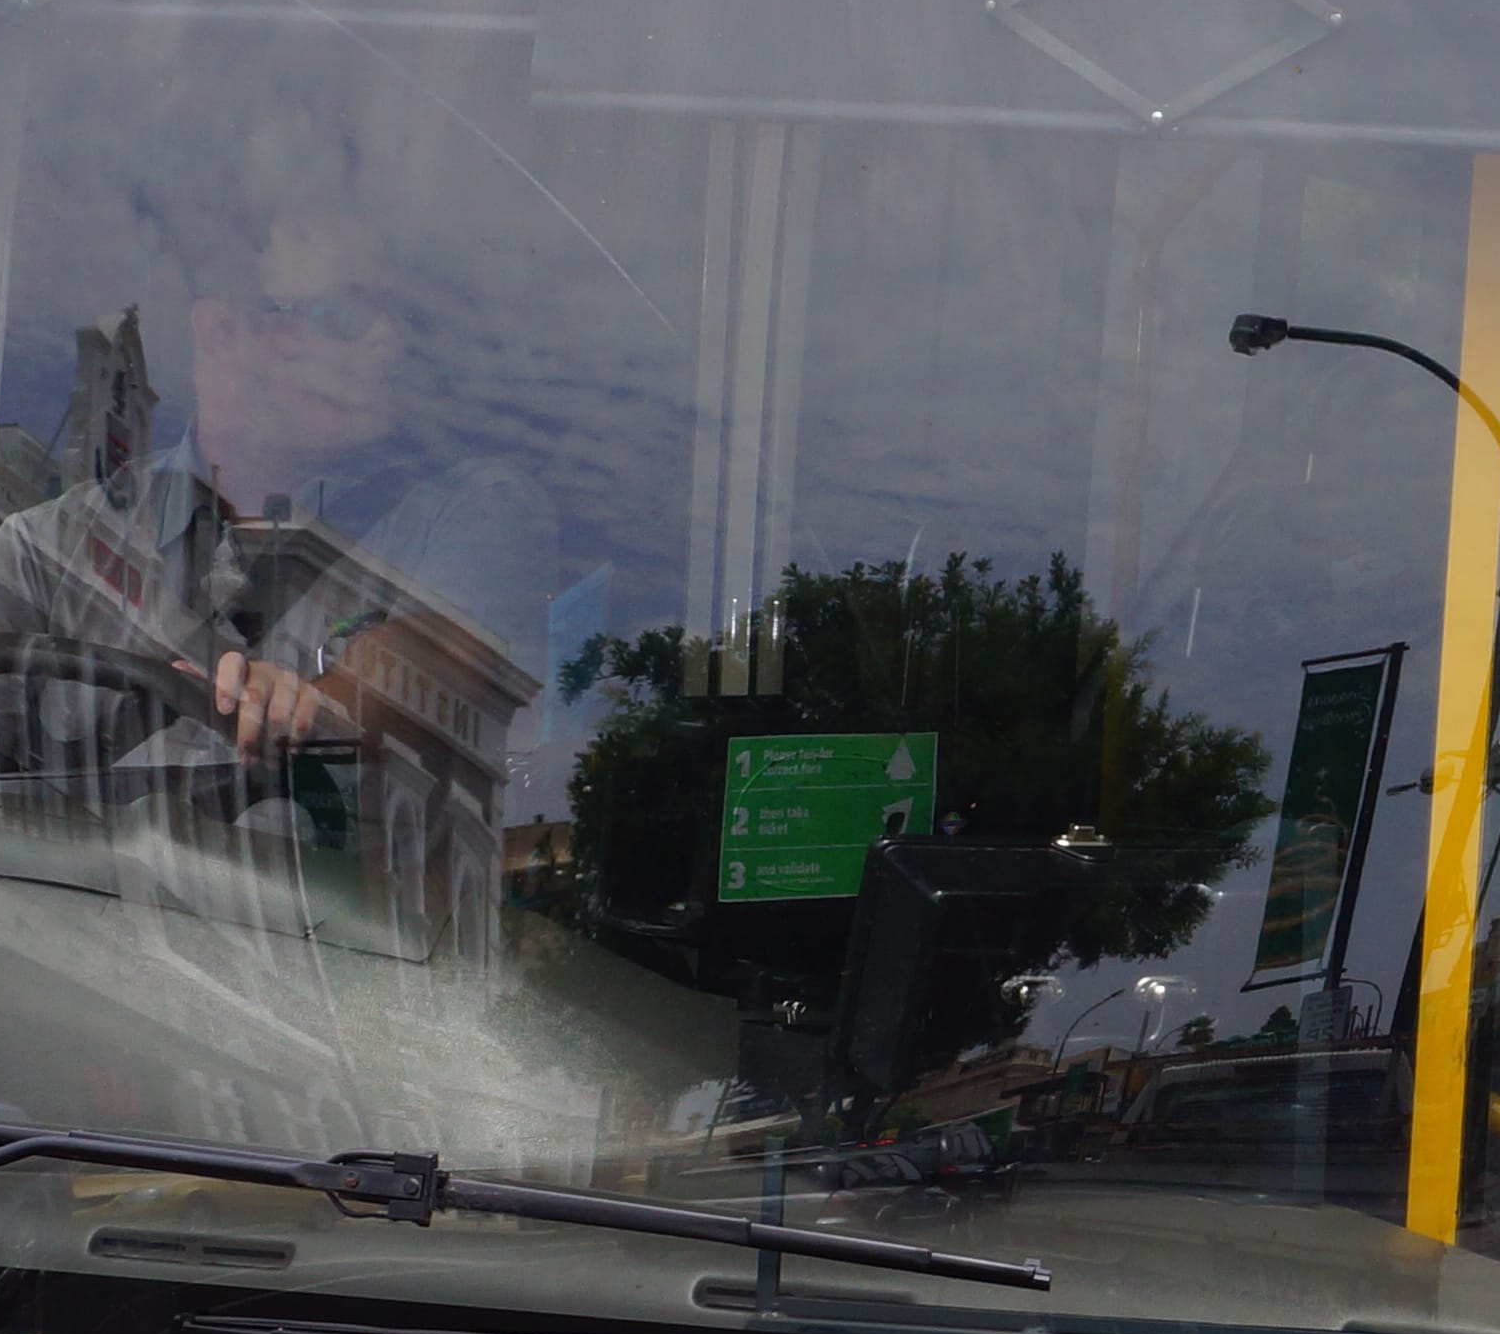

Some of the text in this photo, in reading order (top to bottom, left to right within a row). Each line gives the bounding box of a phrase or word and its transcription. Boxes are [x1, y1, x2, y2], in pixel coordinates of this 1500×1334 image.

[735, 750, 751, 778] 1
[731, 807, 749, 836] 2
[727, 861, 746, 889] 3
